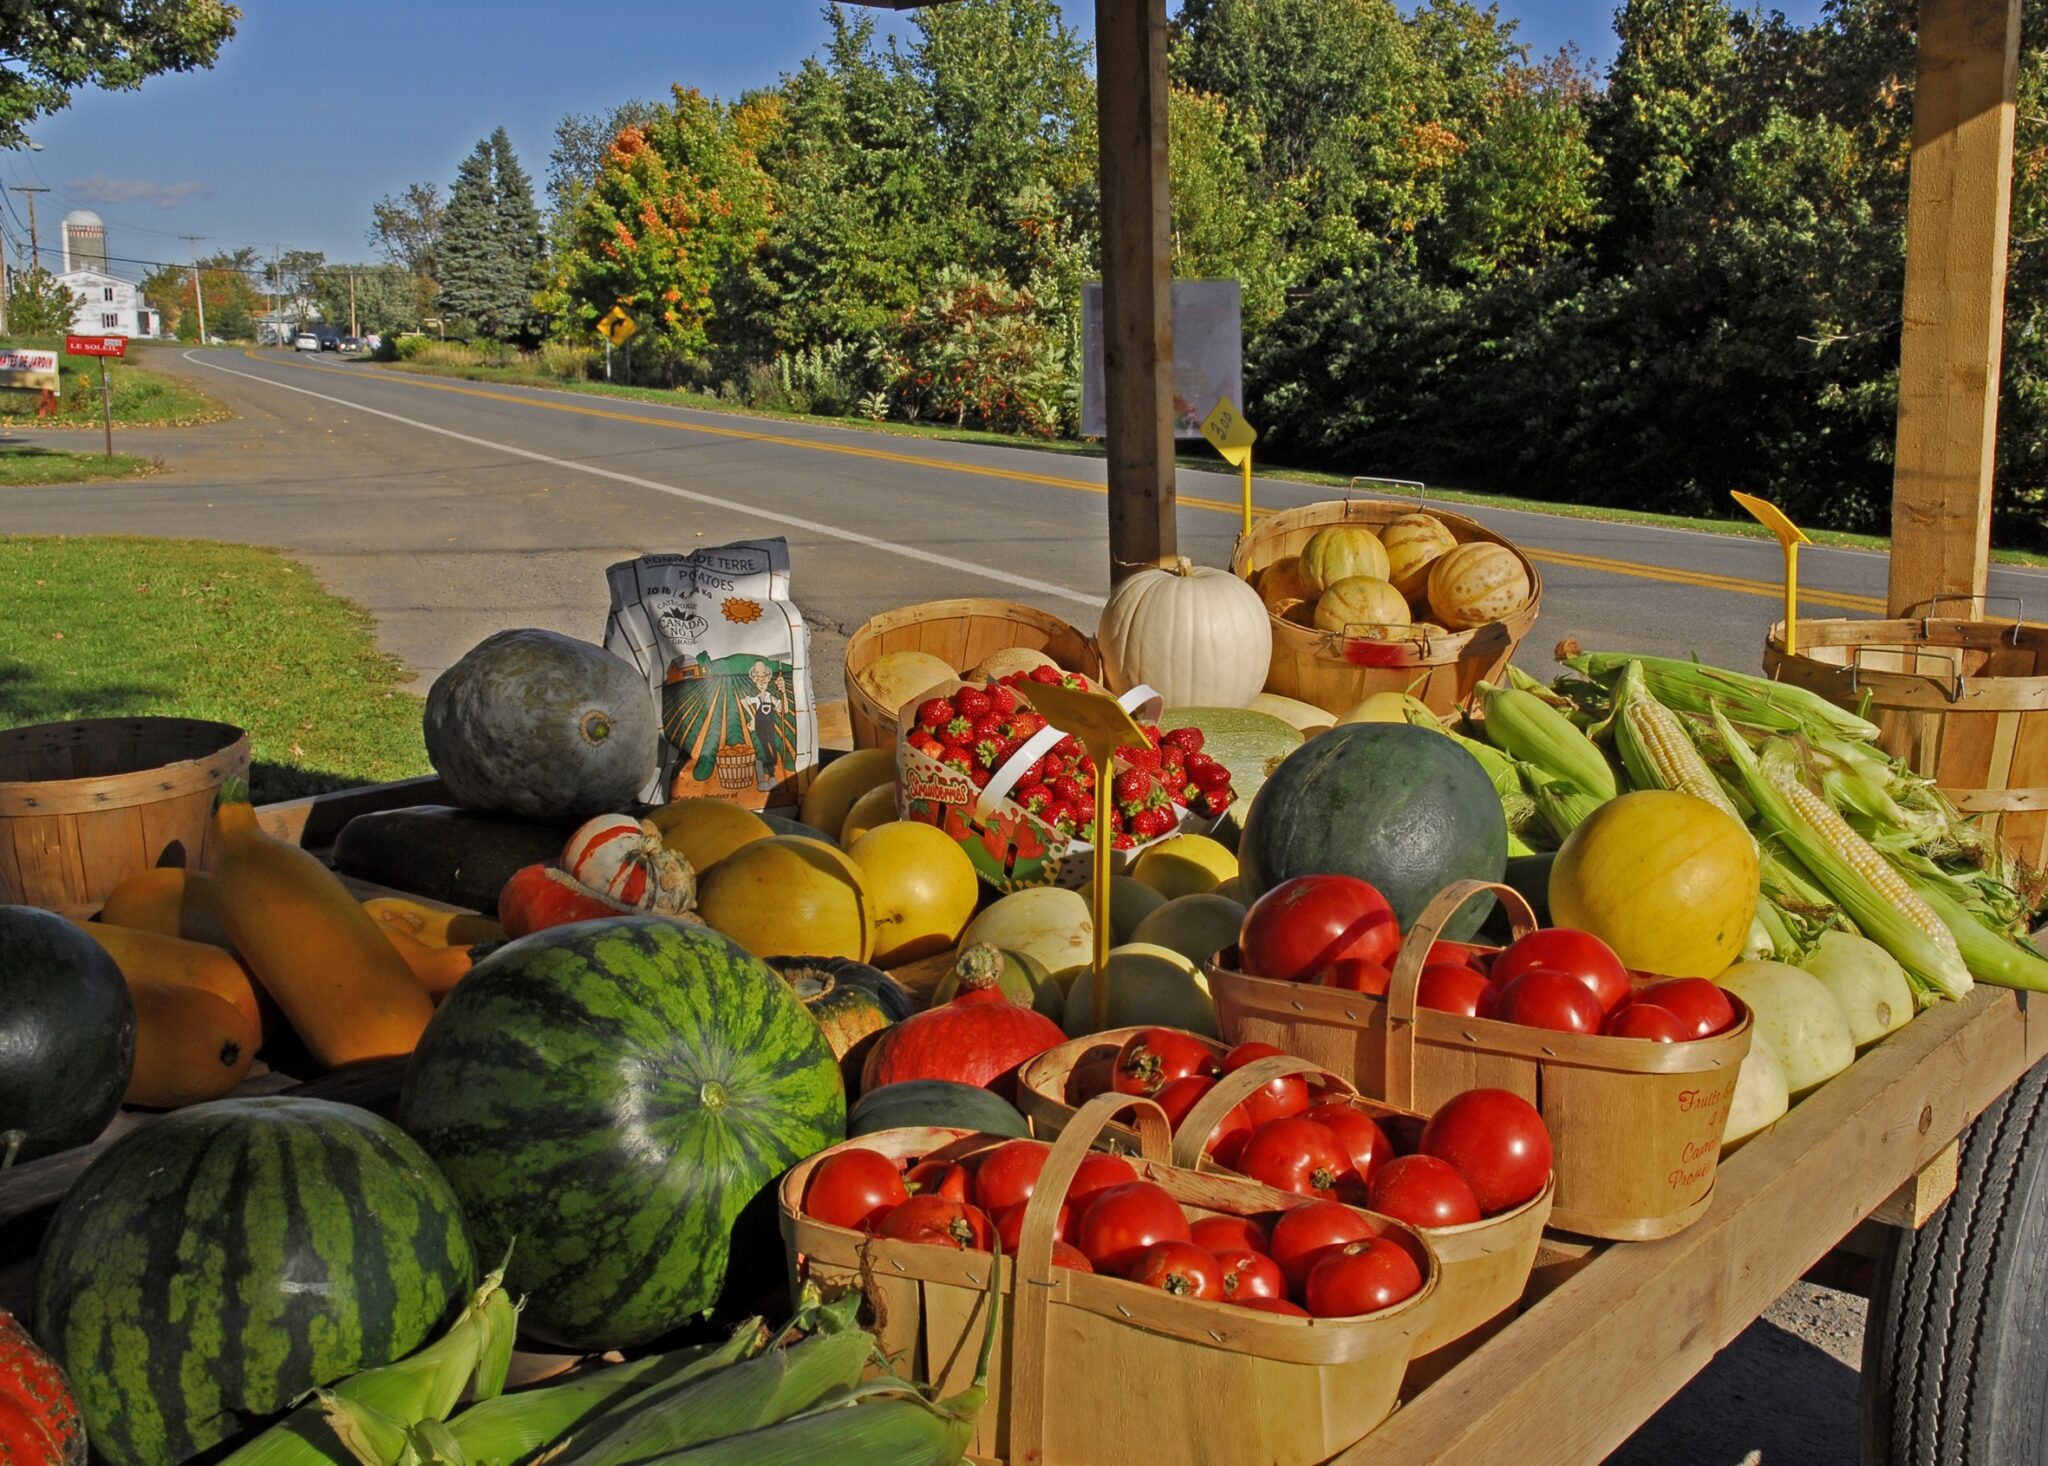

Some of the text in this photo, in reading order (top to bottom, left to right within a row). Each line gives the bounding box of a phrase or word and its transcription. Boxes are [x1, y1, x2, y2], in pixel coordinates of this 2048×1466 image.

[84, 344, 118, 352] SOLEIL
[29, 356, 53, 369] JARDIN
[697, 555, 714, 567] DE
[718, 557, 755, 571] TERRE
[679, 570, 735, 592] POATOES
[647, 587, 659, 596] 10
[662, 586, 671, 595] lb
[660, 618, 705, 631] CANADA
[908, 771, 968, 803] Strawberries
[1678, 1088, 1721, 1112] Fruits
